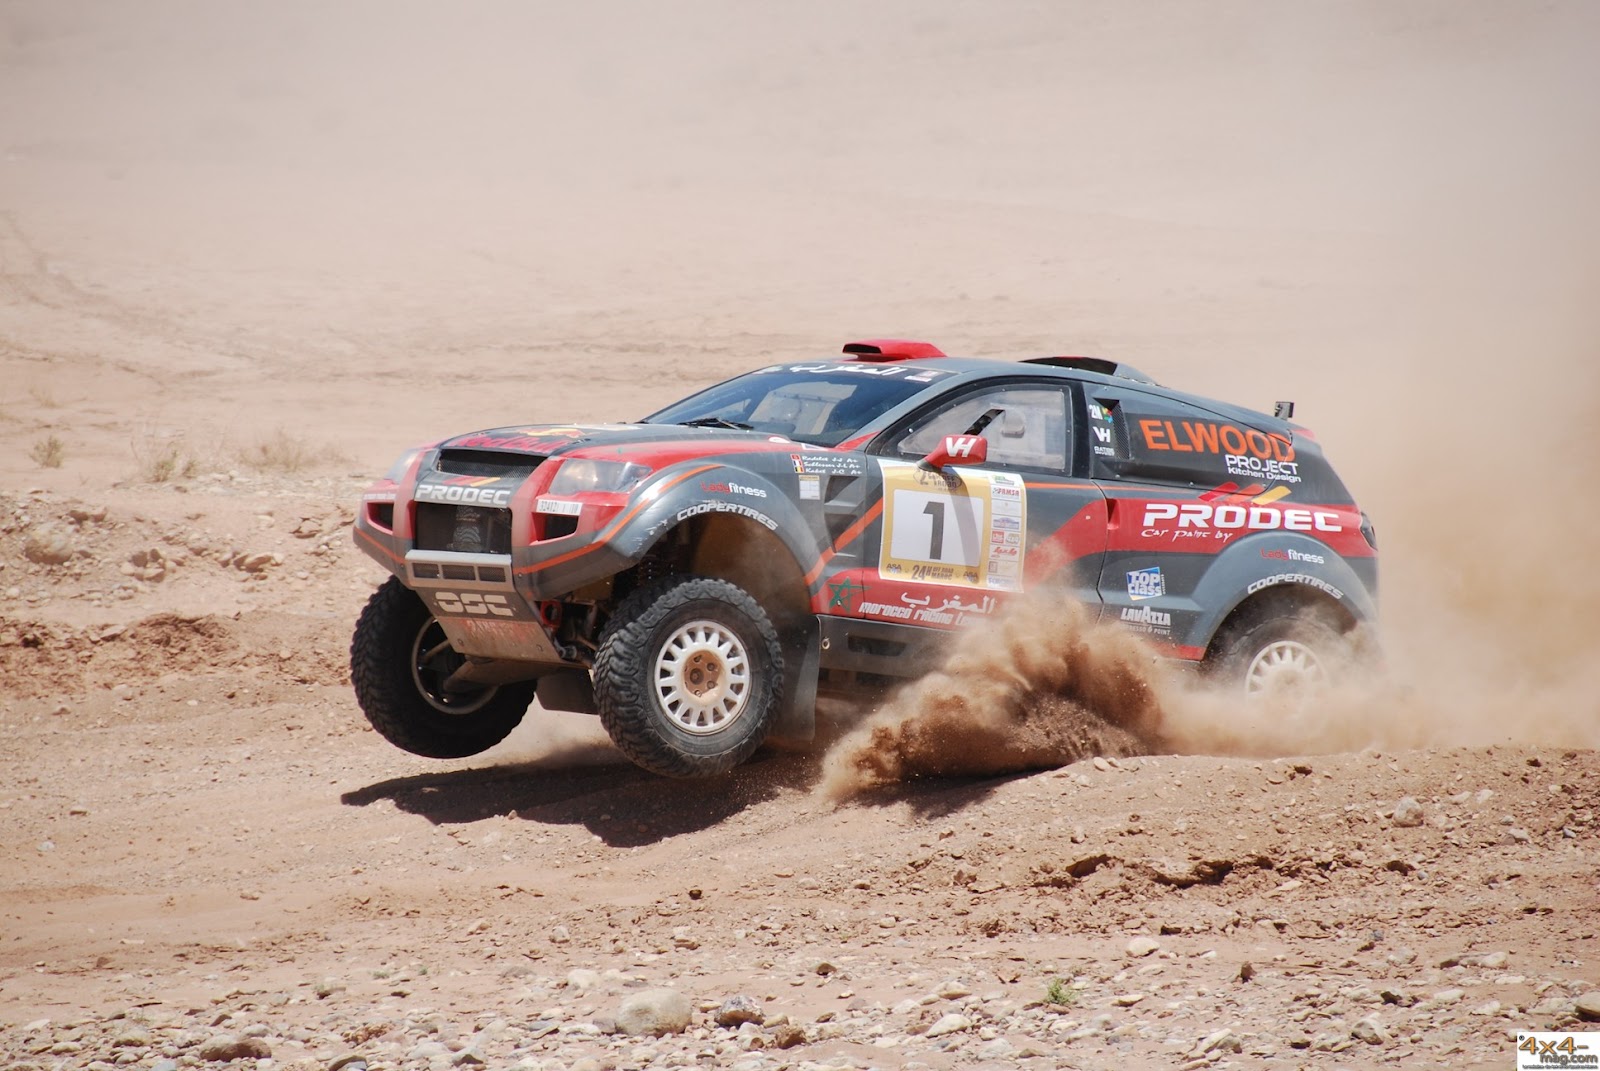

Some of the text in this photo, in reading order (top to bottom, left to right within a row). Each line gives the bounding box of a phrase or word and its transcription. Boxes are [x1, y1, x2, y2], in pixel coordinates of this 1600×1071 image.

[1092, 426, 1111, 443] VH
[1138, 419, 1296, 462] ELWOOD
[945, 437, 977, 458] VH
[1225, 454, 1299, 475] PROJECT
[1228, 467, 1302, 484] Kitchen Design
[415, 484, 511, 506] PRODEC
[1142, 503, 1343, 532] PRODEC
[923, 501, 945, 560] 1
[1141, 528, 1169, 538] Car
[1214, 531, 1234, 543] by
[1129, 572, 1160, 587] TOP
[1247, 573, 1344, 600] COOPERTIRES
[901, 592, 996, 614] المغرب
